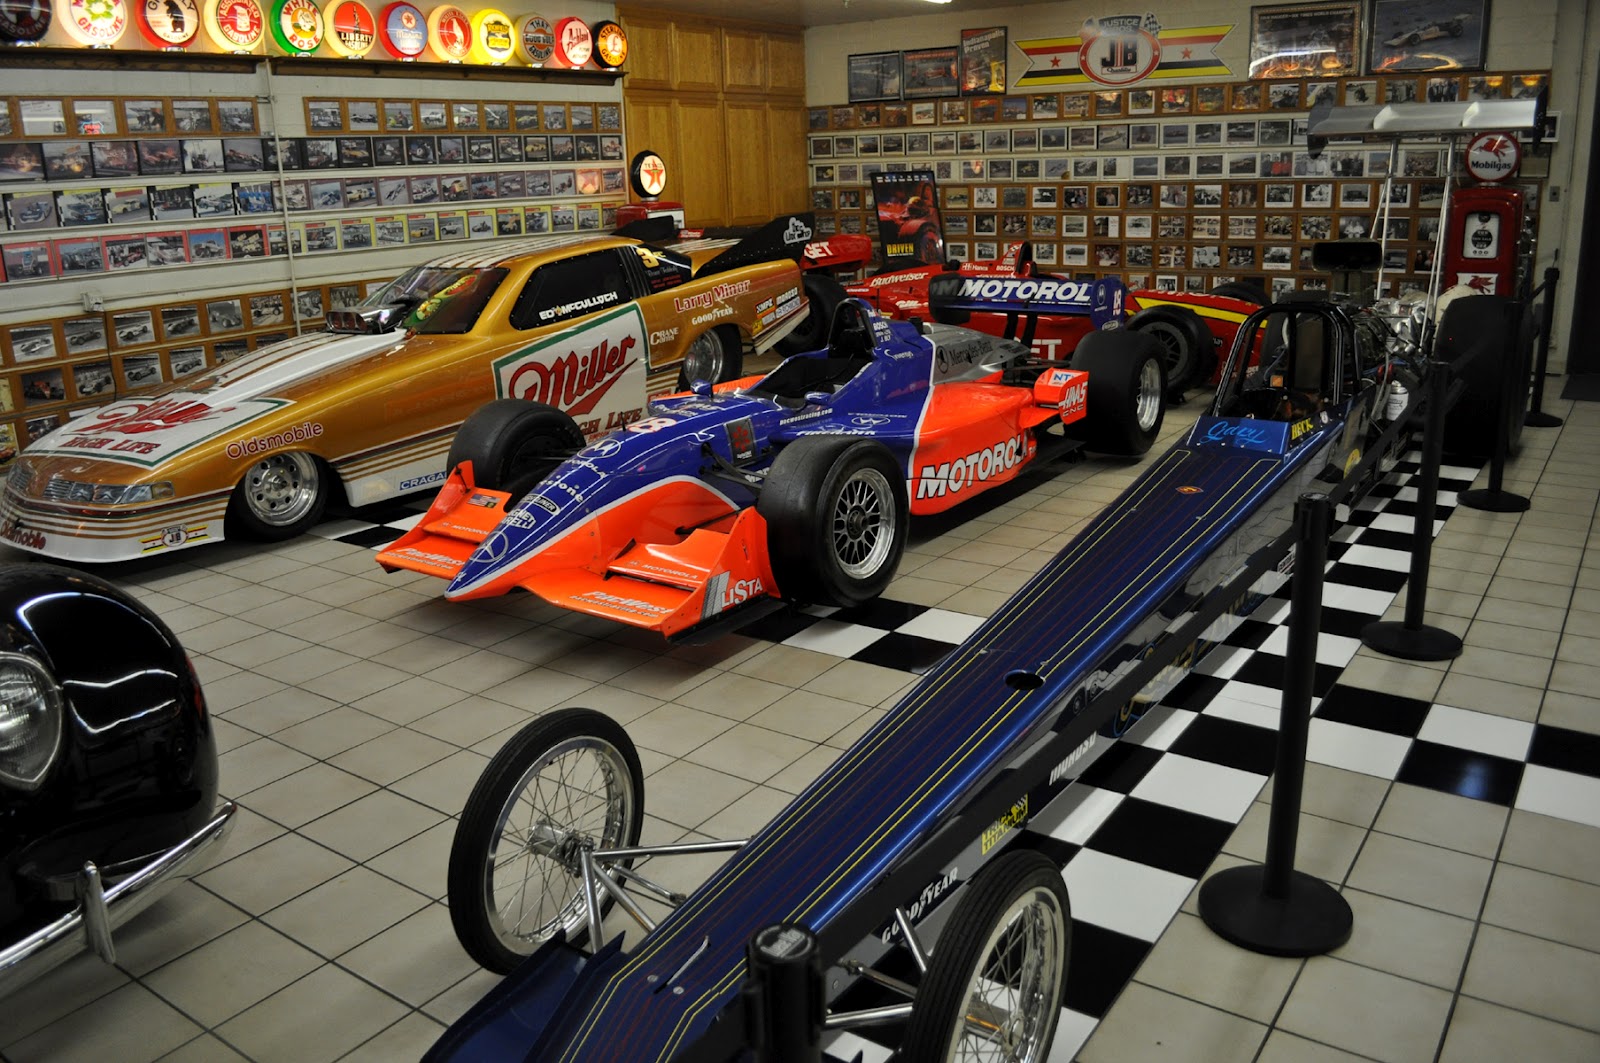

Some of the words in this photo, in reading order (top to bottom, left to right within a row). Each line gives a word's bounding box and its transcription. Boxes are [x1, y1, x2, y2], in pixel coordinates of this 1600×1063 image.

[78, 16, 123, 38] GASOLINE
[531, 19, 549, 29] THAT
[1103, 18, 1139, 27] JUSTICE
[223, 24, 260, 43] GASOLINE
[289, 35, 320, 49] ROSE
[341, 32, 373, 43] LIBERTY
[963, 28, 1006, 48] Indianapolis
[528, 45, 552, 60] GASOLINE
[963, 41, 990, 54] Proven
[1471, 160, 1512, 171] Mobilgas
[804, 241, 834, 259] GET
[886, 243, 914, 254] DRIVEN
[636, 248, 660, 268] 3
[870, 272, 929, 288] Budweiser
[673, 292, 713, 314] Larry
[711, 279, 751, 302] Minor
[958, 279, 1092, 302] MOTOROL
[539, 309, 554, 321] ED
[691, 306, 734, 326] GOODYEAR
[873, 321, 889, 331] BOSCH
[509, 334, 636, 409] Miller
[1053, 373, 1075, 381] NT
[605, 408, 643, 430] LIFE
[1063, 404, 1084, 417] CNC
[1199, 420, 1268, 444] Gary
[1291, 418, 1314, 441] BECK
[58, 436, 115, 449] HIGH
[108, 439, 162, 455] LIFE
[226, 420, 324, 460] Oldsmobile
[401, 472, 447, 489] CRAGA
[451, 525, 490, 535] MOTOROL
[642, 564, 699, 580] MOTOROLA
[582, 591, 675, 615] PacWest
[881, 866, 958, 945] GODYEAR
